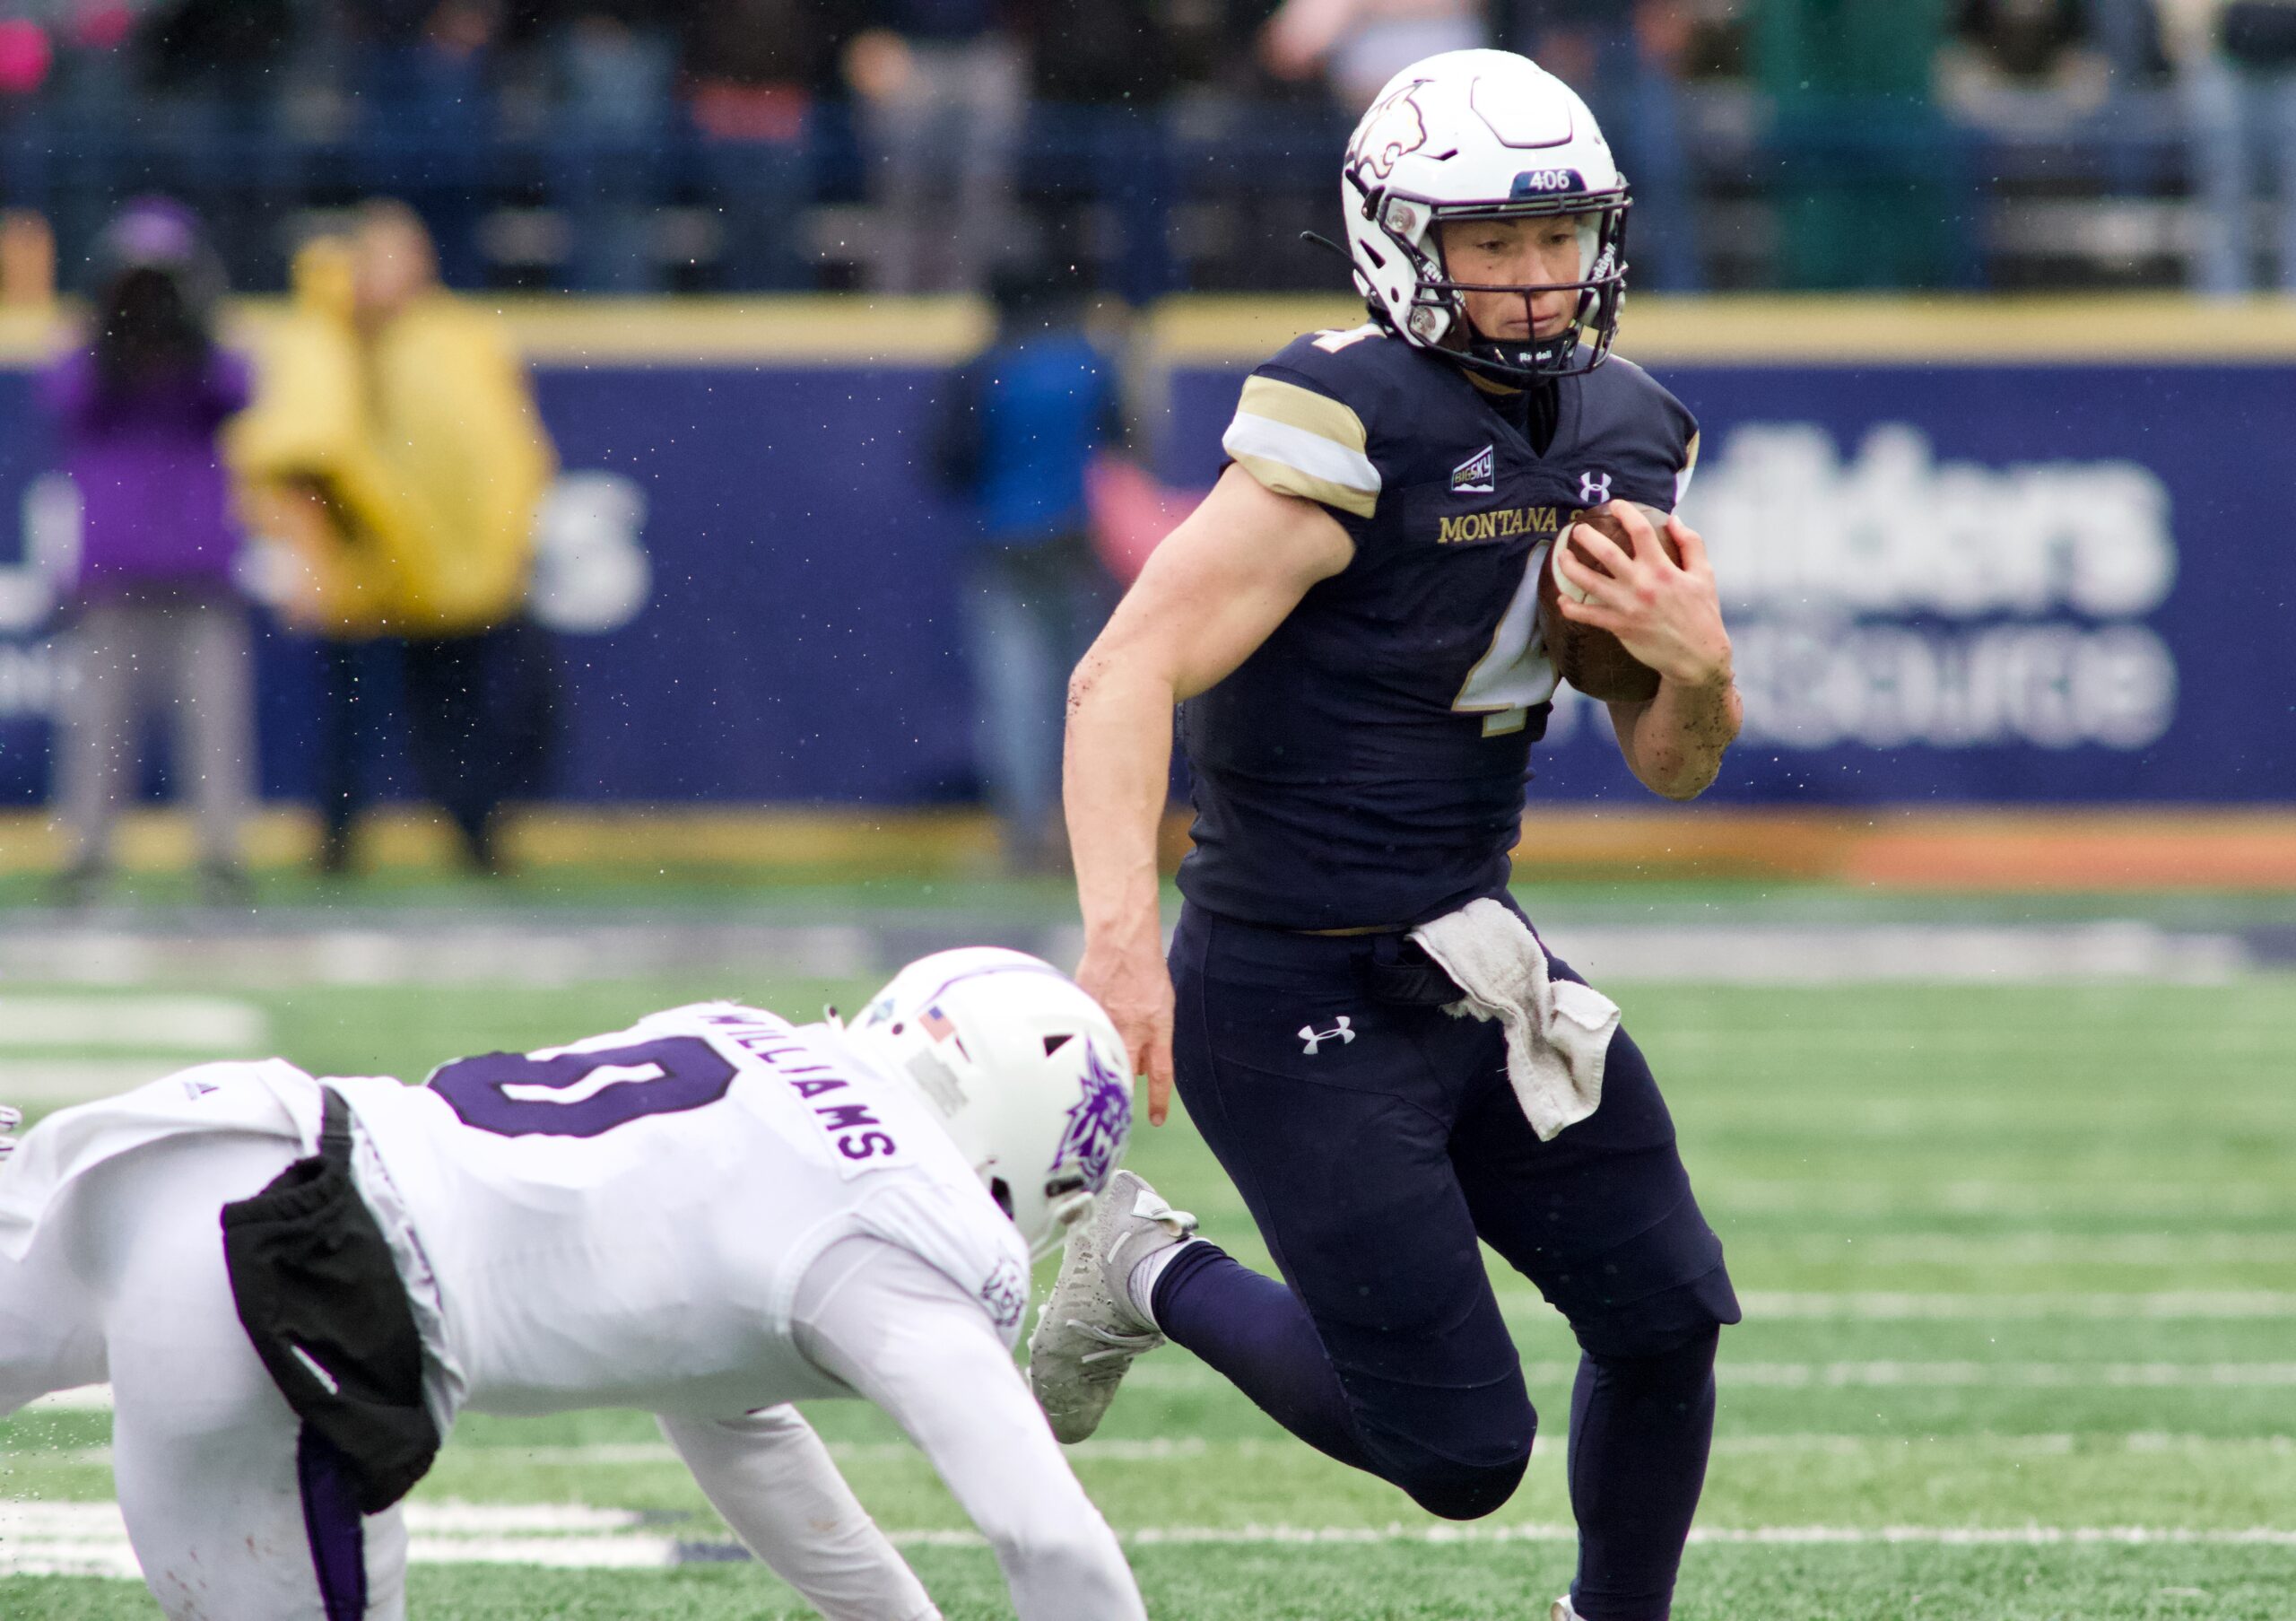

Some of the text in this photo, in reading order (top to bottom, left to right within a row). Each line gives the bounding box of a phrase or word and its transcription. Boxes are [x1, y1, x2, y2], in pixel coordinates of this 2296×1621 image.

[1529, 170, 1570, 190] 406
[1438, 507, 1558, 544] MONTANA
[427, 1035, 740, 1138] 0
[697, 1013, 897, 1160] WILLIAMS
